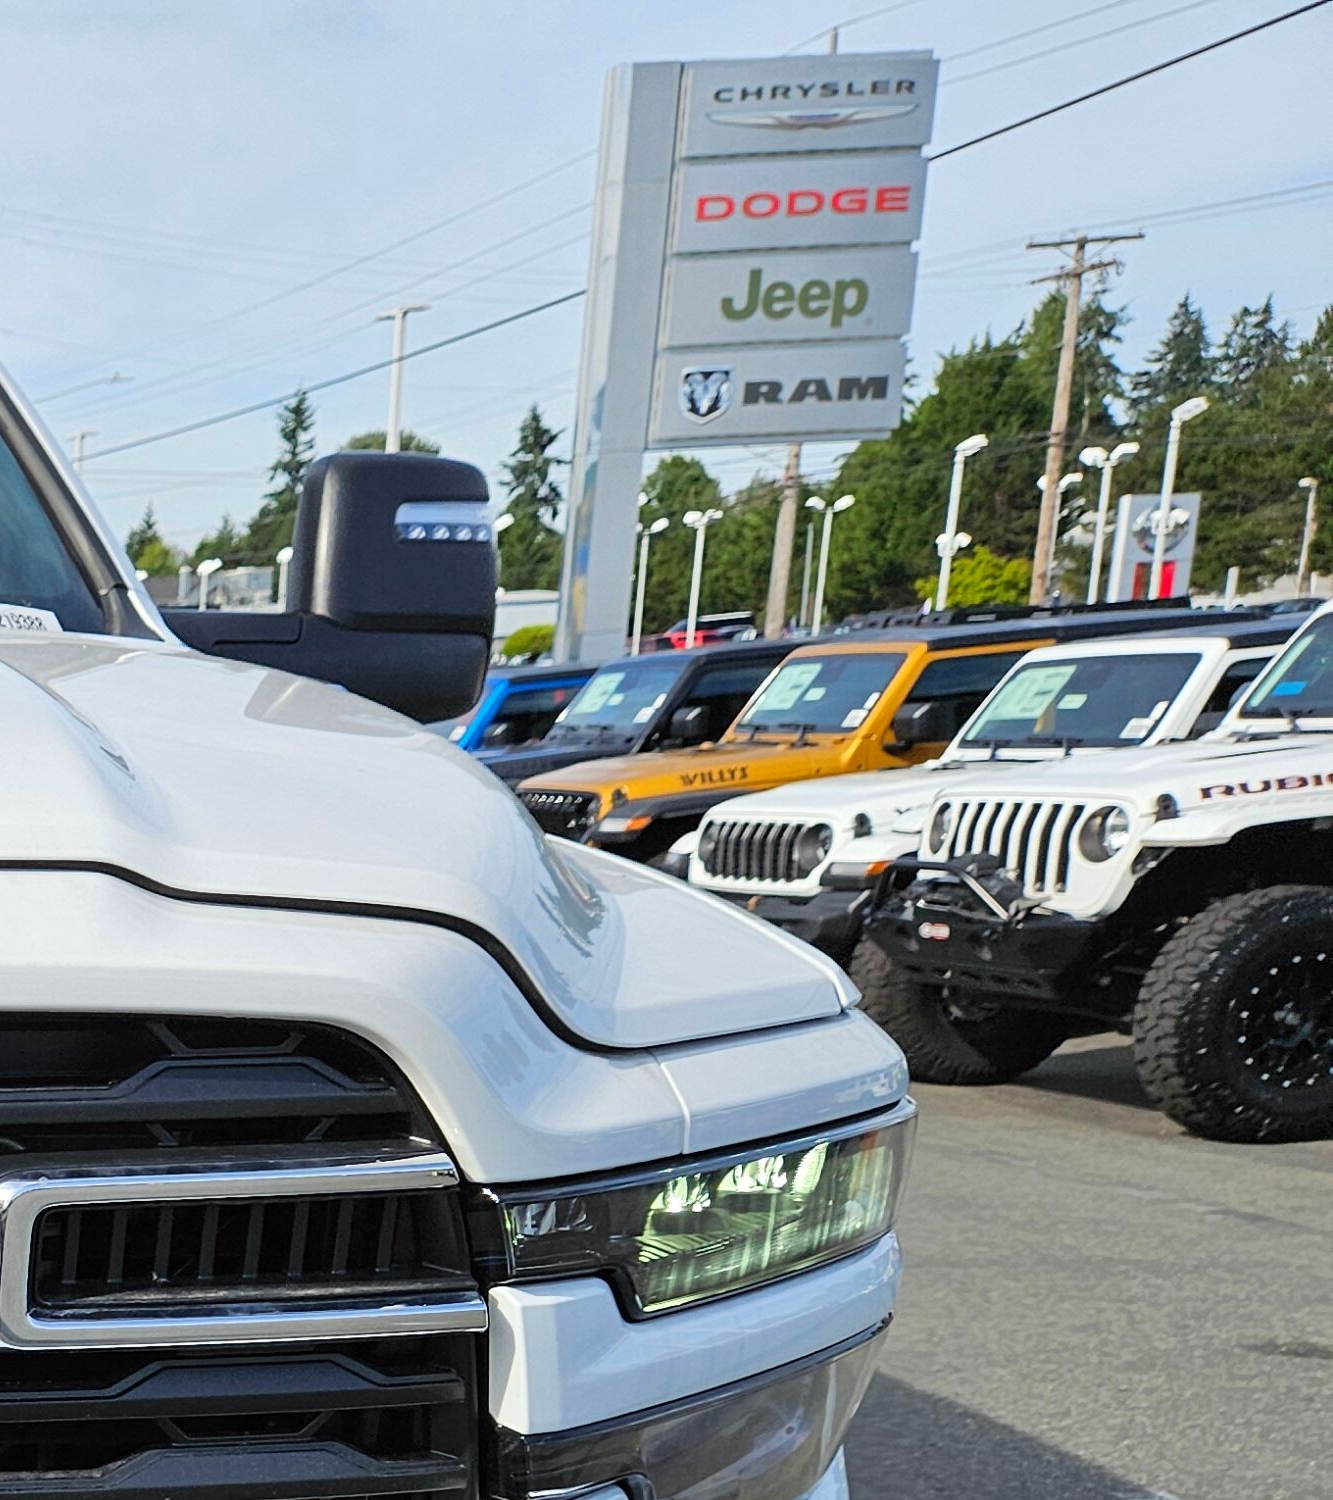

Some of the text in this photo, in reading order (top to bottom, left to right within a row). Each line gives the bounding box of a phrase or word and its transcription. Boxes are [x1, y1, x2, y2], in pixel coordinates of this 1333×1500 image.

[713, 79, 916, 103] CHRYSLER
[695, 185, 912, 222] DODGE
[720, 267, 870, 328] Jeep
[742, 375, 889, 406] RAM
[680, 765, 750, 786] WILLYS
